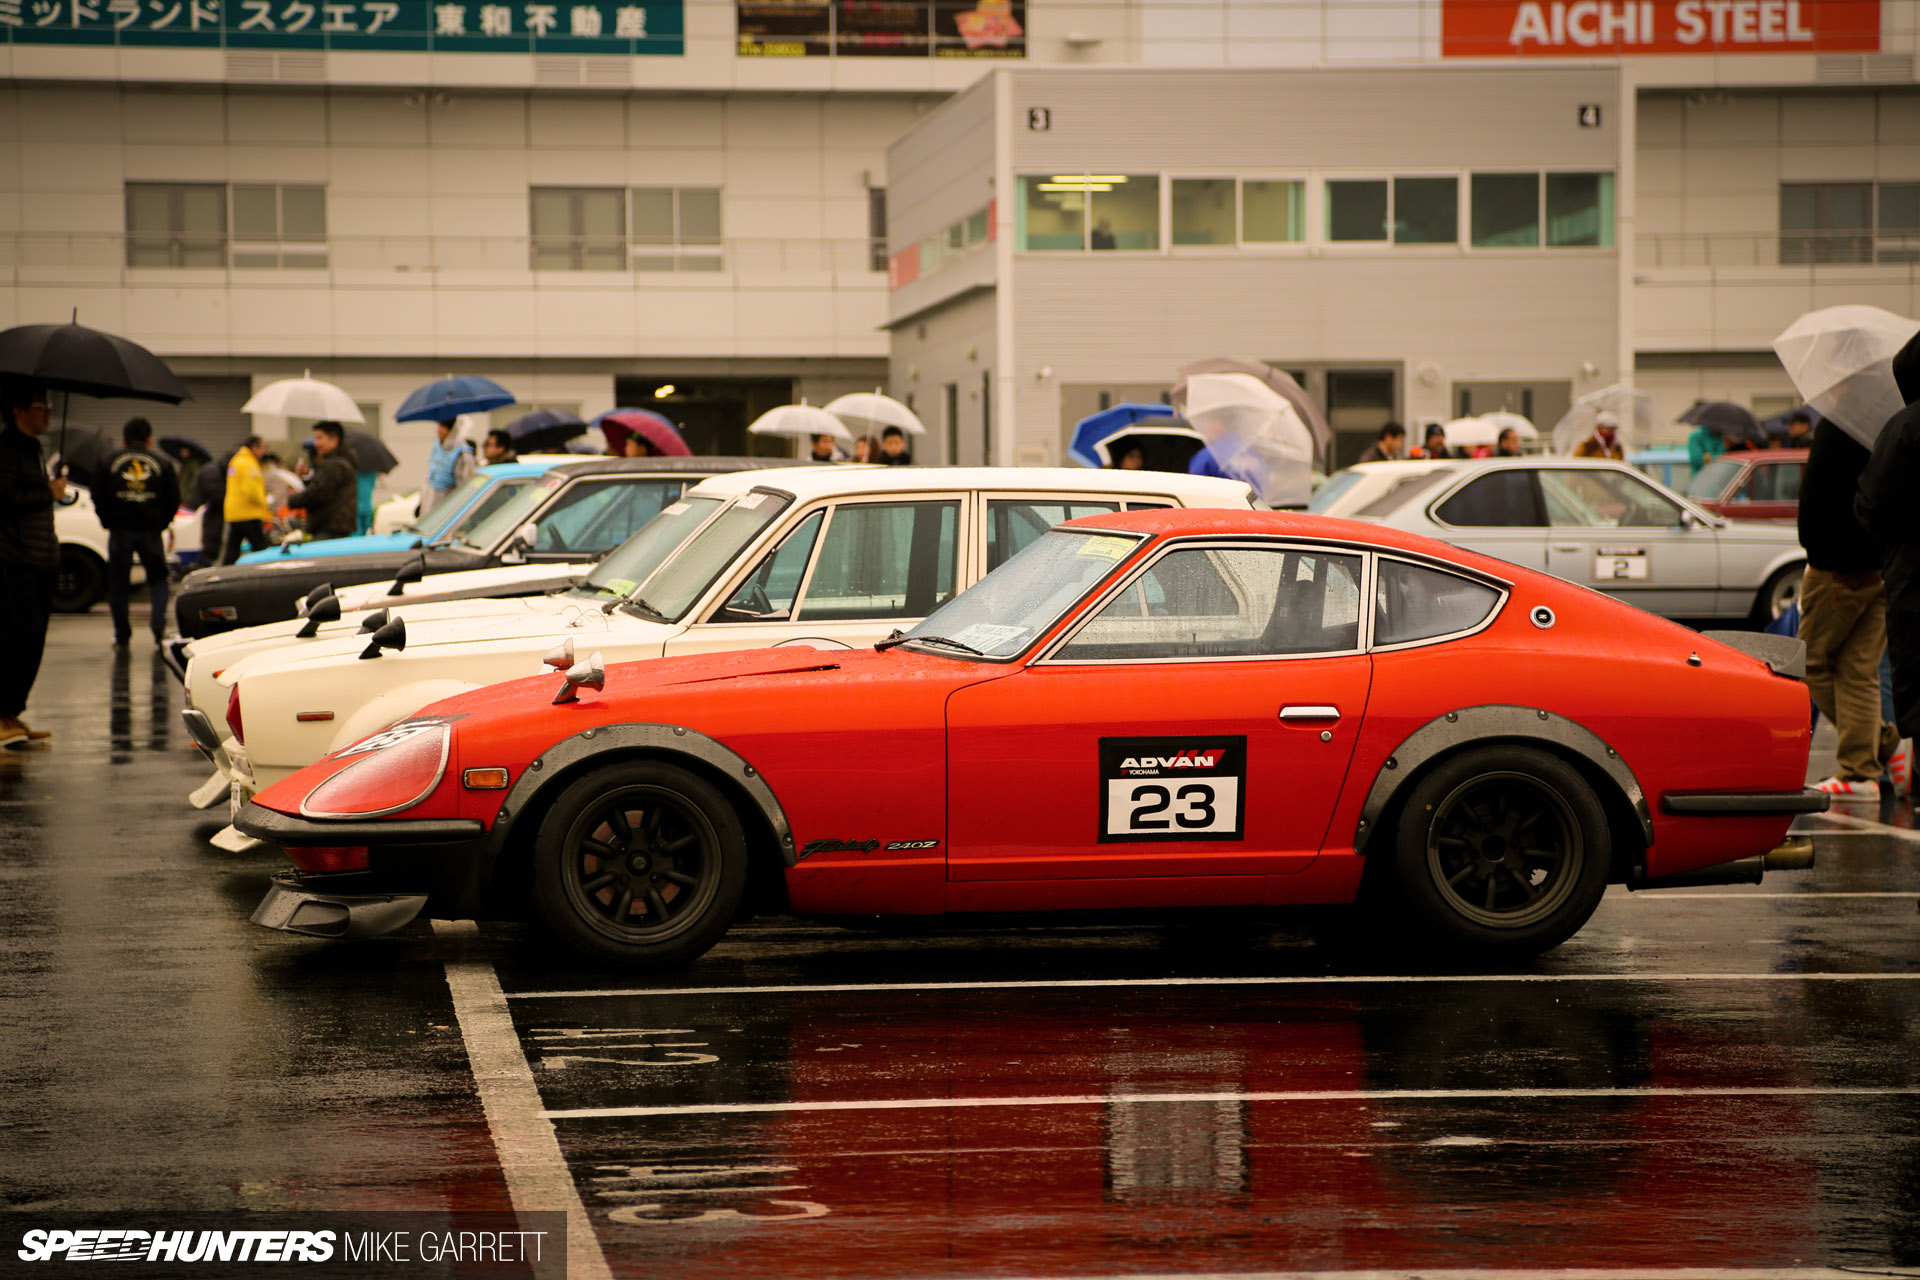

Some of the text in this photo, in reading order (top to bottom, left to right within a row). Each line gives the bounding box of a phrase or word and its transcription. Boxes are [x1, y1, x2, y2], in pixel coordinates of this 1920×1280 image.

[238, 1, 400, 34] スクエア
[434, 4, 648, 38] 東和不動産
[1509, 0, 1814, 46] AICHI STEEL
[1032, 108, 1047, 130] 3
[1582, 105, 1597, 127] 4
[1614, 557, 1629, 579] 2
[1120, 756, 1214, 769] ADVAN
[1130, 784, 1216, 830] 23
[884, 840, 939, 851] 240Z
